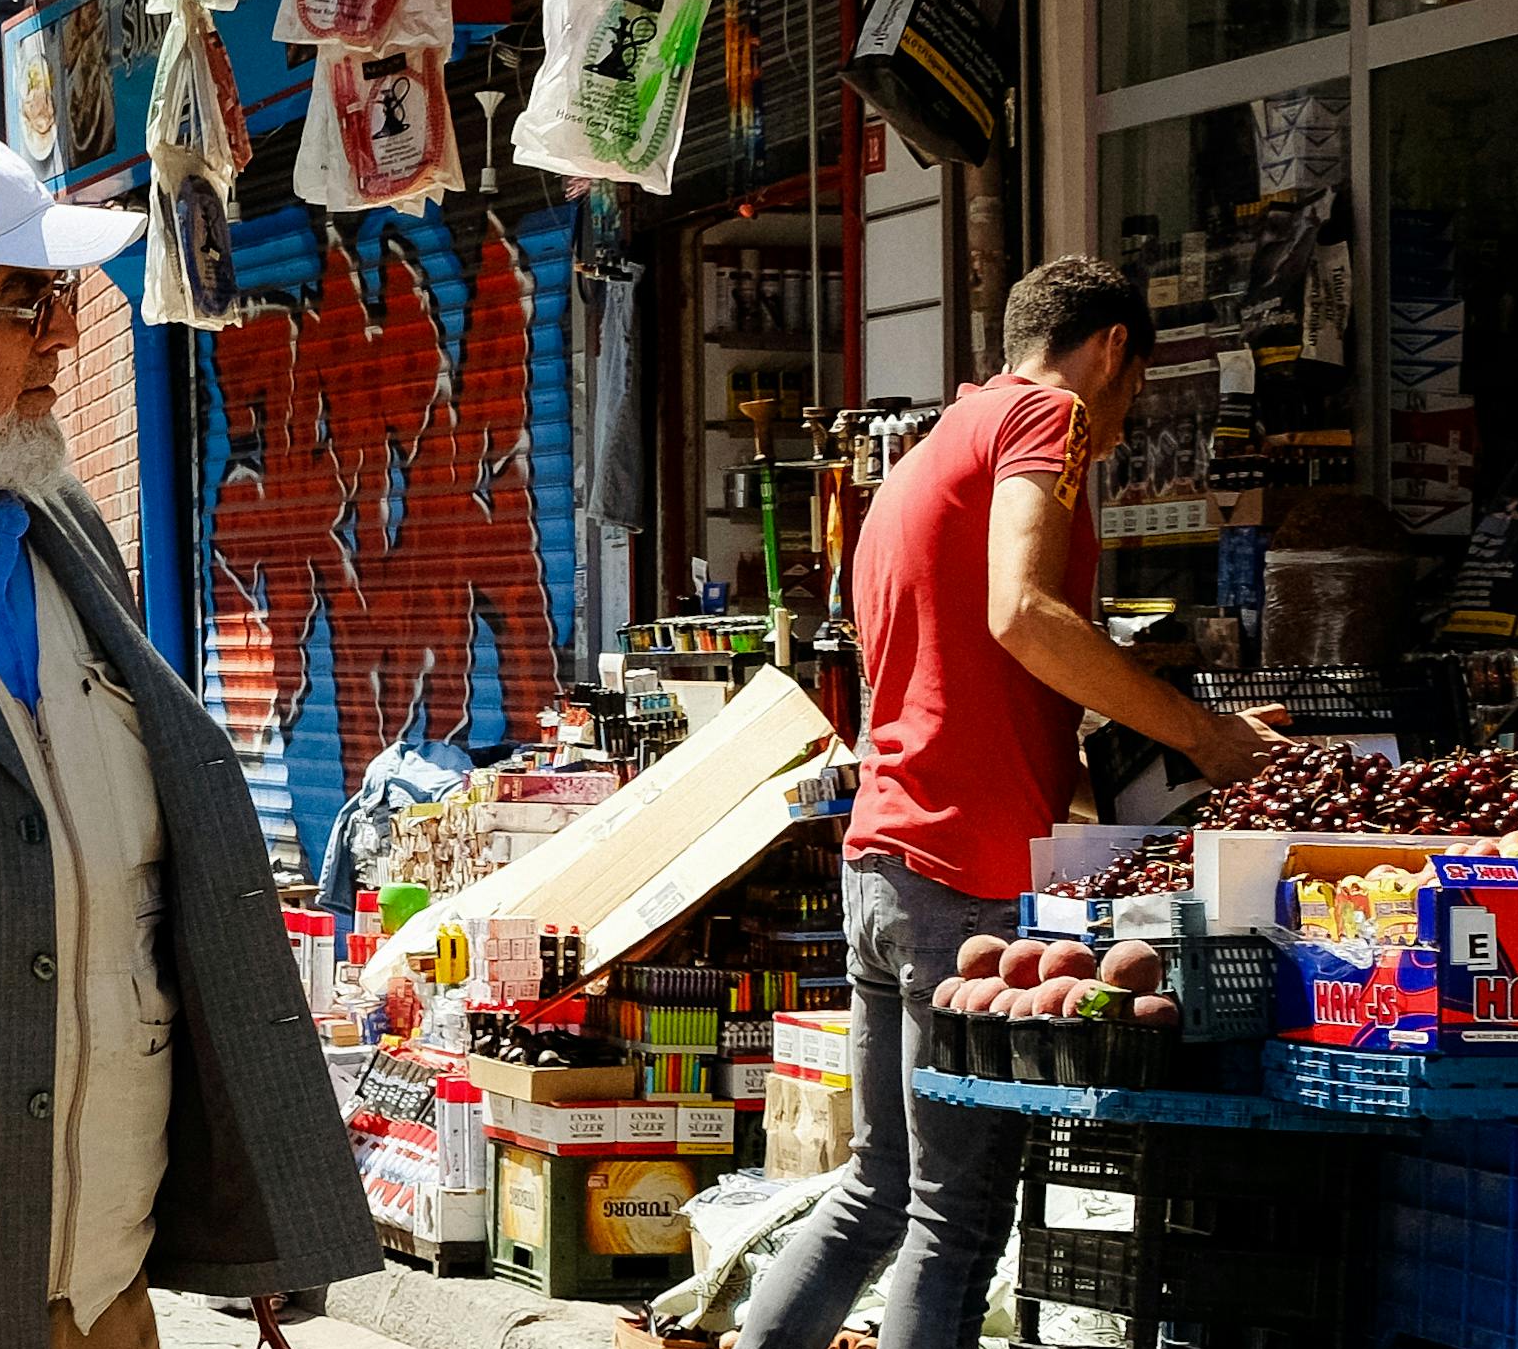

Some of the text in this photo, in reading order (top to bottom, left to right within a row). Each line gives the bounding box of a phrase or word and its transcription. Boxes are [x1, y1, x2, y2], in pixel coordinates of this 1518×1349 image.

[1468, 933, 1490, 959] E
[1314, 979, 1363, 1027] HAK
[569, 1112, 602, 1122] EXTRA
[630, 1112, 662, 1121] EXTRA
[690, 1112, 722, 1121] EXTRA
[603, 1200, 672, 1217] TUBORG
